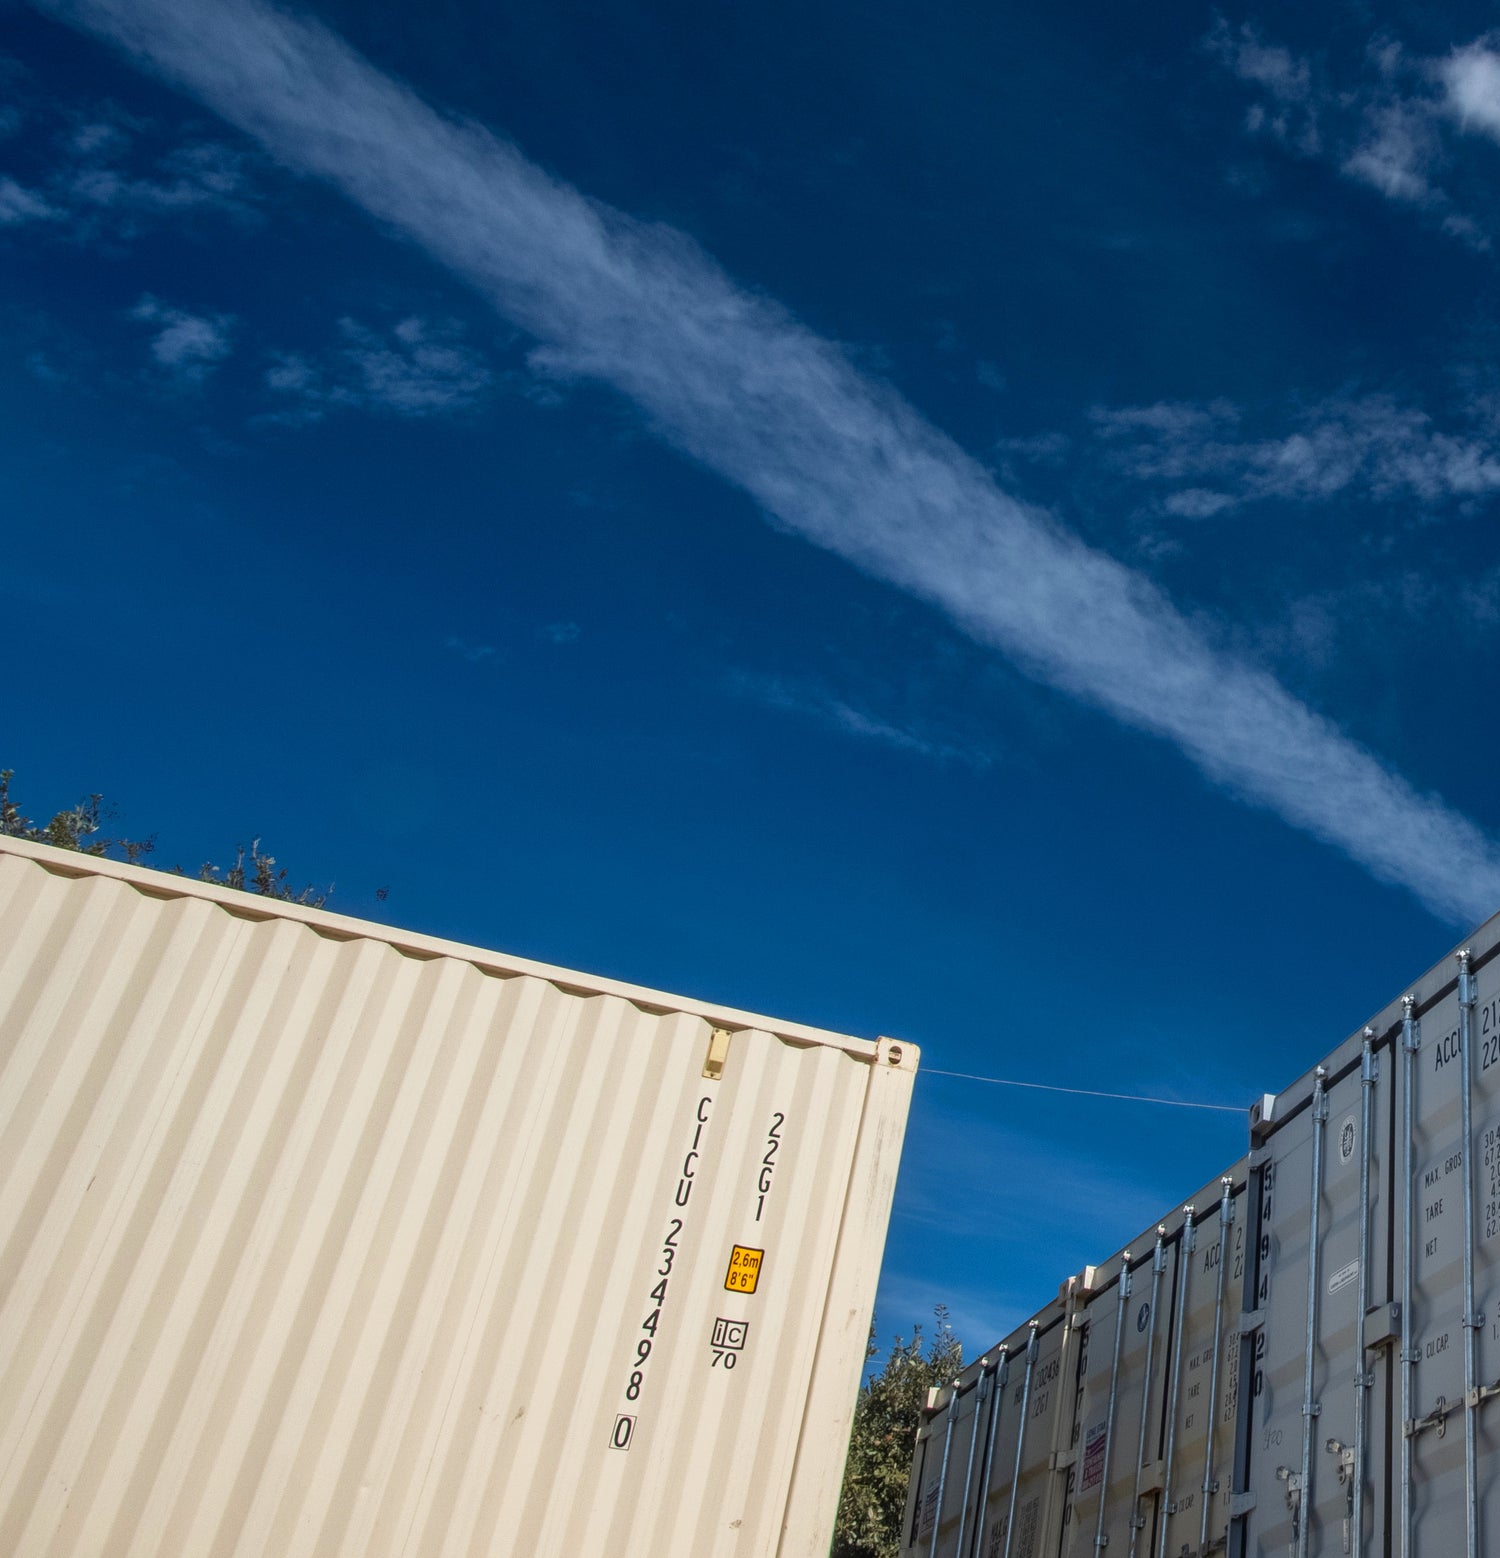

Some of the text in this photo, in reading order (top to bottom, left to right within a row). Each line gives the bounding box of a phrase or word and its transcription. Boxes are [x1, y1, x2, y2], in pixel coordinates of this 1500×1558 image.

[675, 1096, 712, 1208] CICU
[1445, 1151, 1463, 1176] GROS
[755, 1111, 785, 1222] 22G1
[1425, 1198, 1444, 1223] TARE
[733, 1251, 759, 1269] 2,6m
[1425, 1237, 1438, 1259] NET
[625, 1218, 683, 1401] 234498
[711, 1349, 737, 1370] 70
